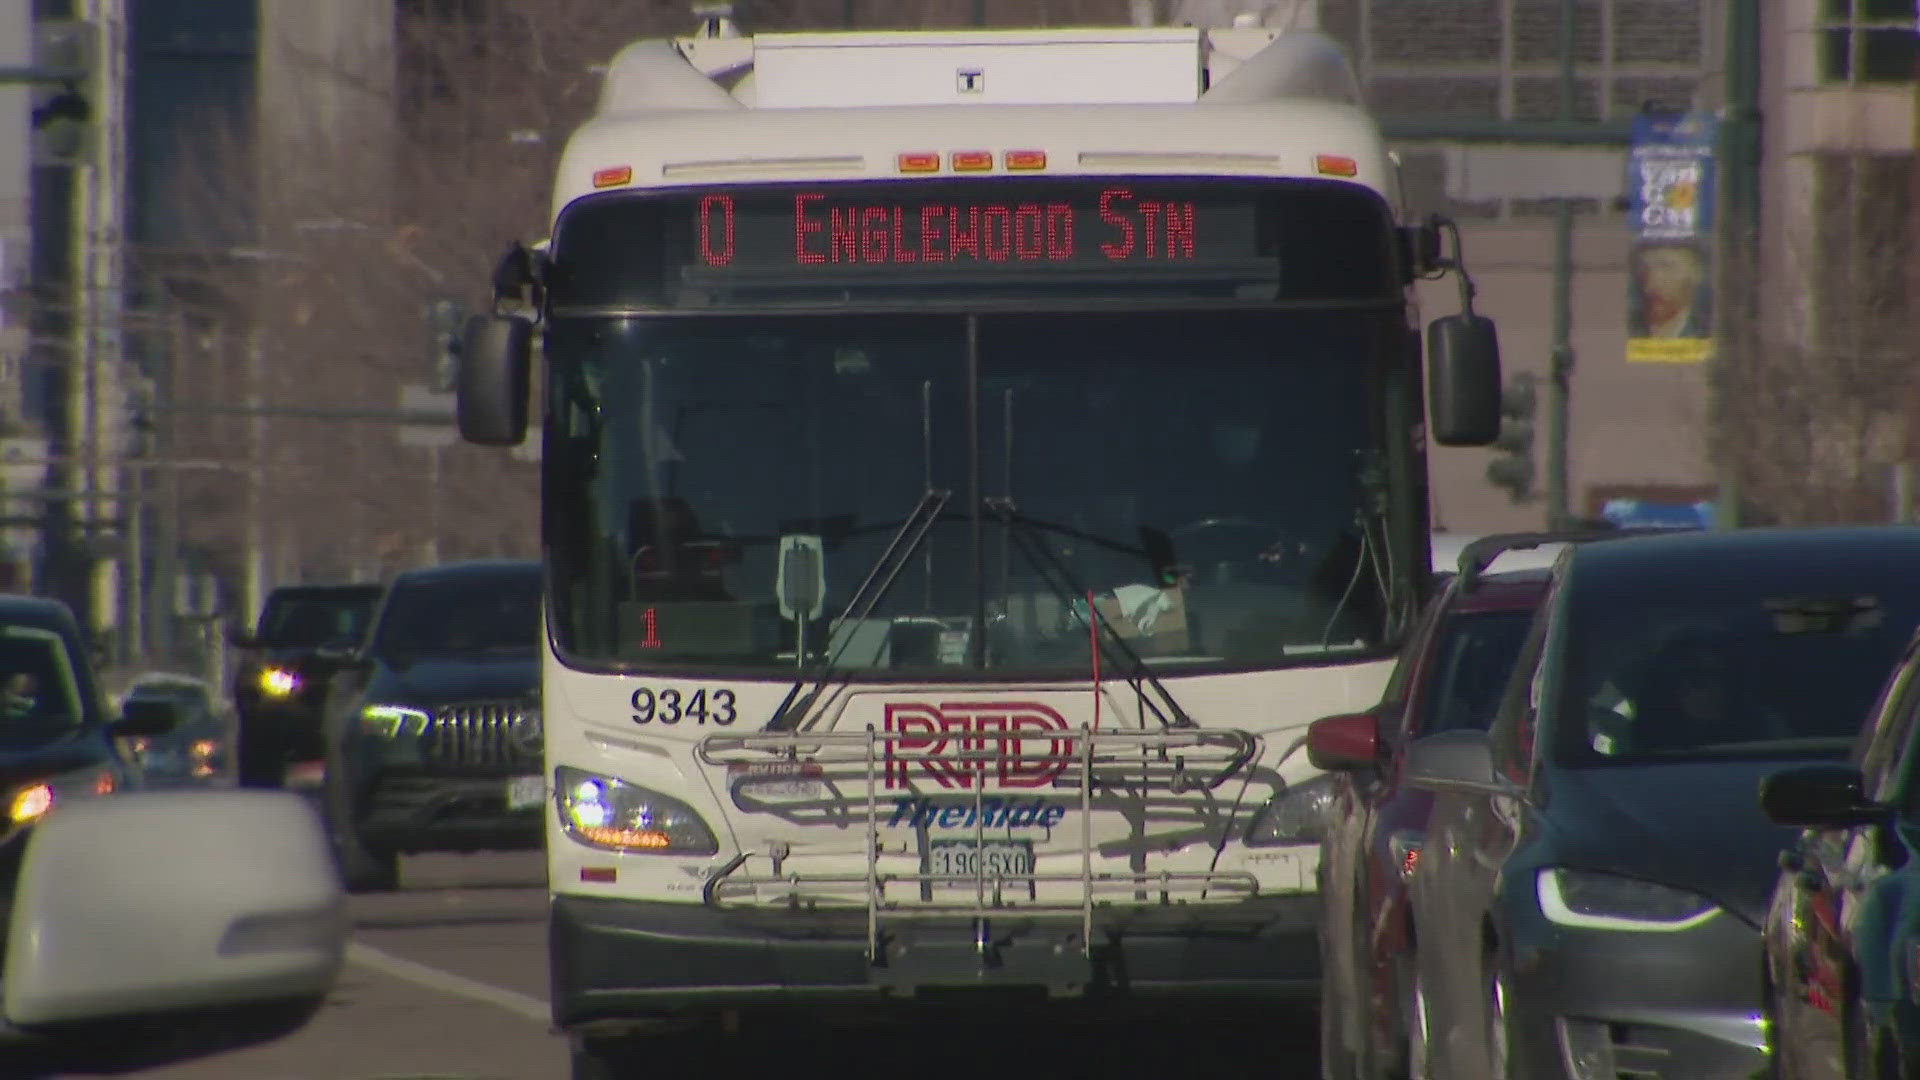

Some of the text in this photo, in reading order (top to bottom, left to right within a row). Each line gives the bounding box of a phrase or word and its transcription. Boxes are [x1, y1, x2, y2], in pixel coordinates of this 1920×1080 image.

[640, 607, 662, 648] 1
[631, 687, 737, 726] 9343
[884, 702, 1073, 790] RTD
